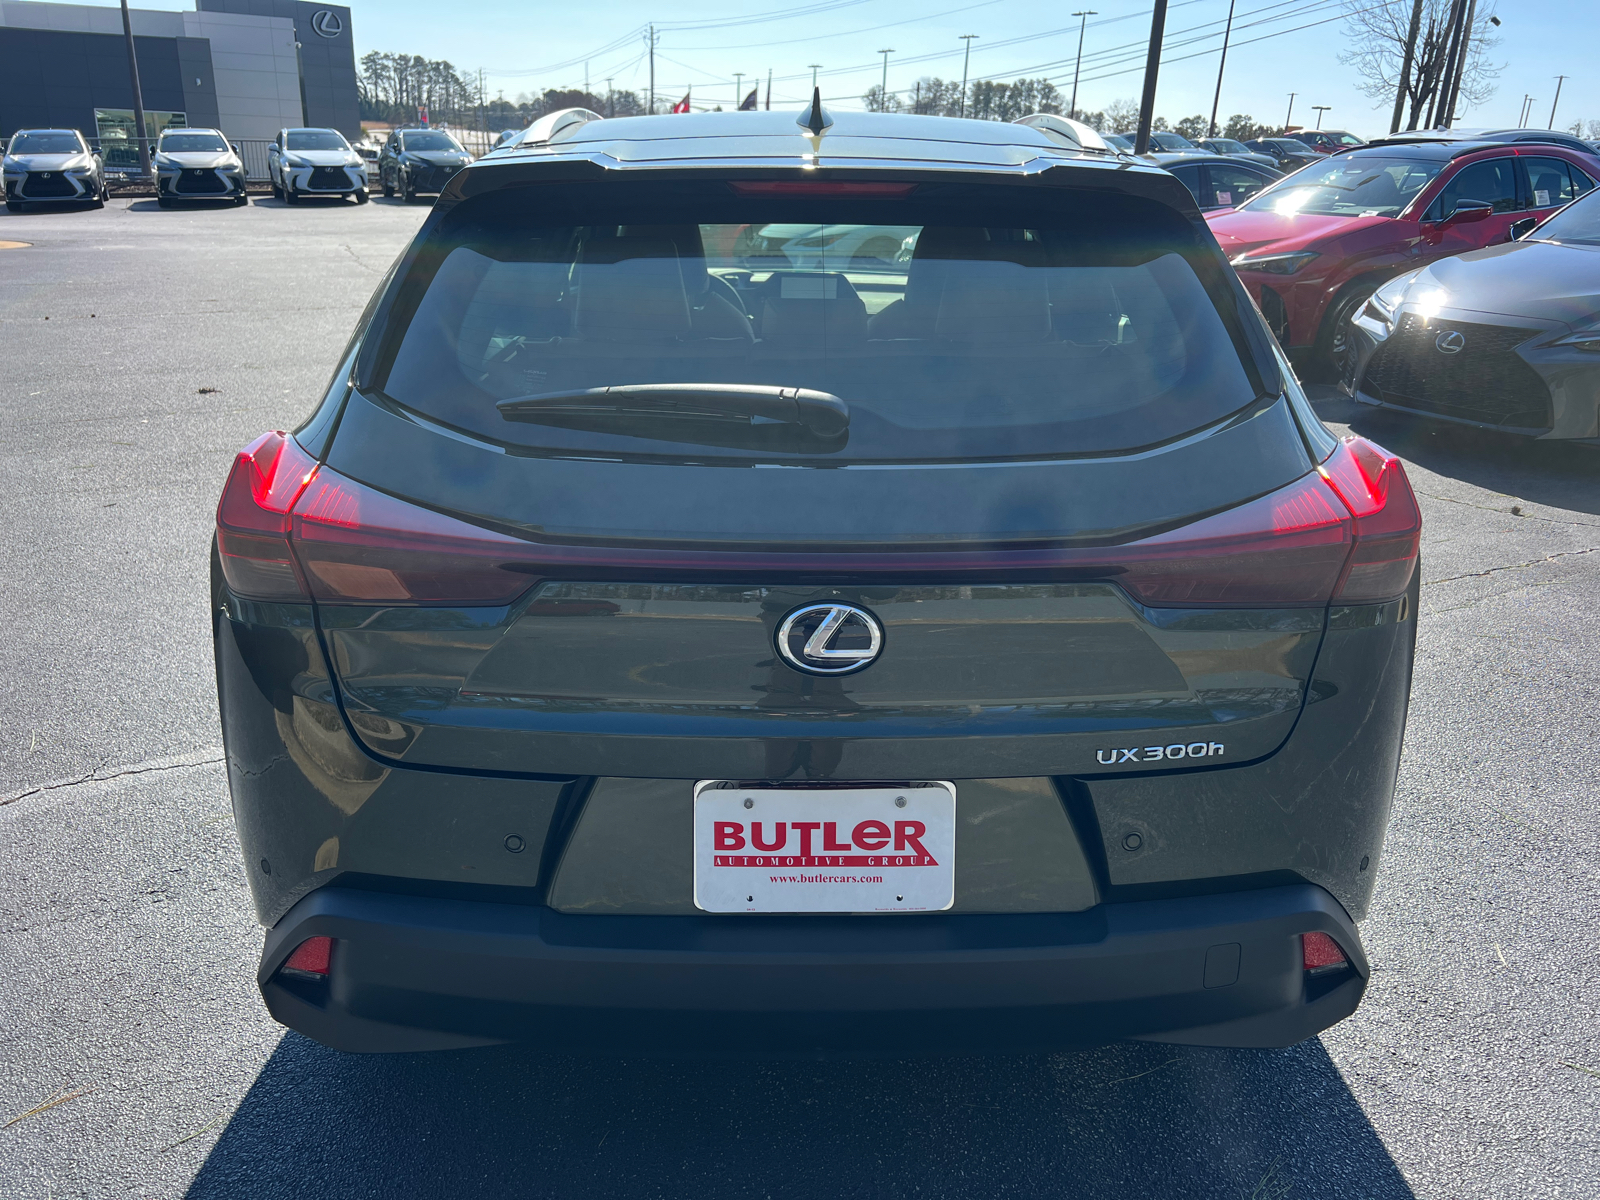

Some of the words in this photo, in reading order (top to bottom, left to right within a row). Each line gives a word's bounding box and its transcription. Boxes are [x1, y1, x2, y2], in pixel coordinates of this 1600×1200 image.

[1096, 747, 1140, 765] UX
[1142, 741, 1225, 761] 300h
[714, 856, 846, 867] AUTOMOTIVE
[867, 855, 931, 866] GROUP
[769, 873, 883, 884] www.butlercars.com
